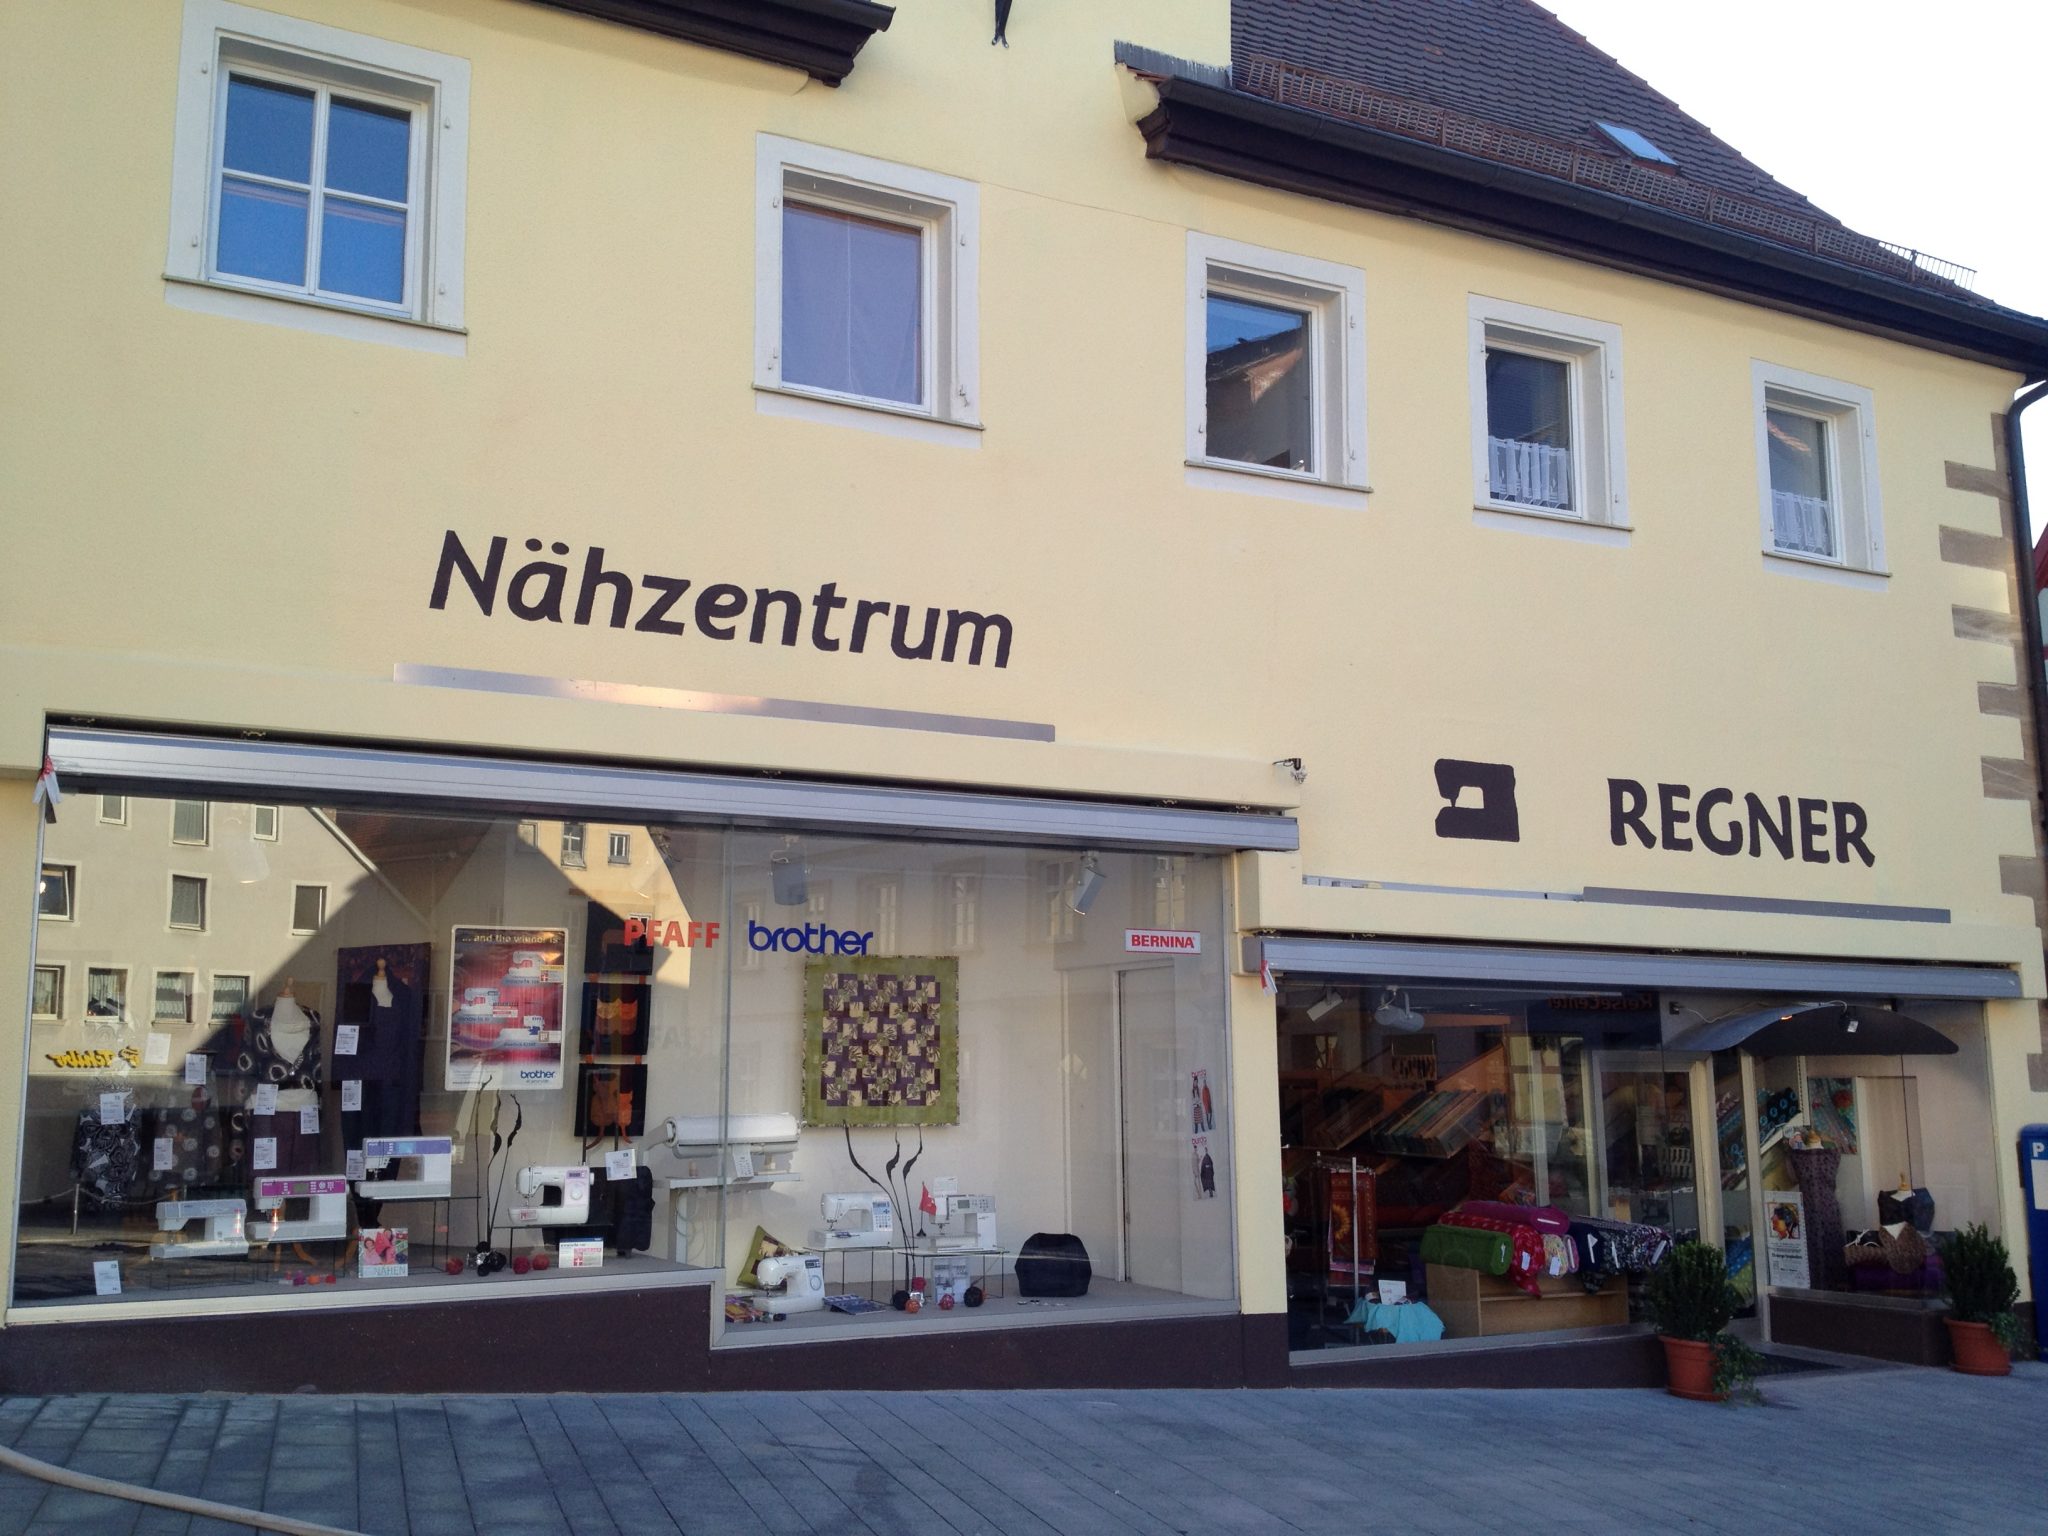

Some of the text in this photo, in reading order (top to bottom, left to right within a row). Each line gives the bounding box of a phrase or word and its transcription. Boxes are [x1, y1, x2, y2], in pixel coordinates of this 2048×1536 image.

[429, 530, 1013, 668] Nähzentrum
[1607, 778, 1876, 867] REGNER
[474, 934, 493, 943] and
[496, 934, 512, 943] the
[624, 919, 720, 948] PFAFF
[749, 920, 873, 955] brother
[1131, 934, 1195, 949] BERNINA
[520, 1070, 556, 1079] brother
[2032, 1142, 2045, 1158] P
